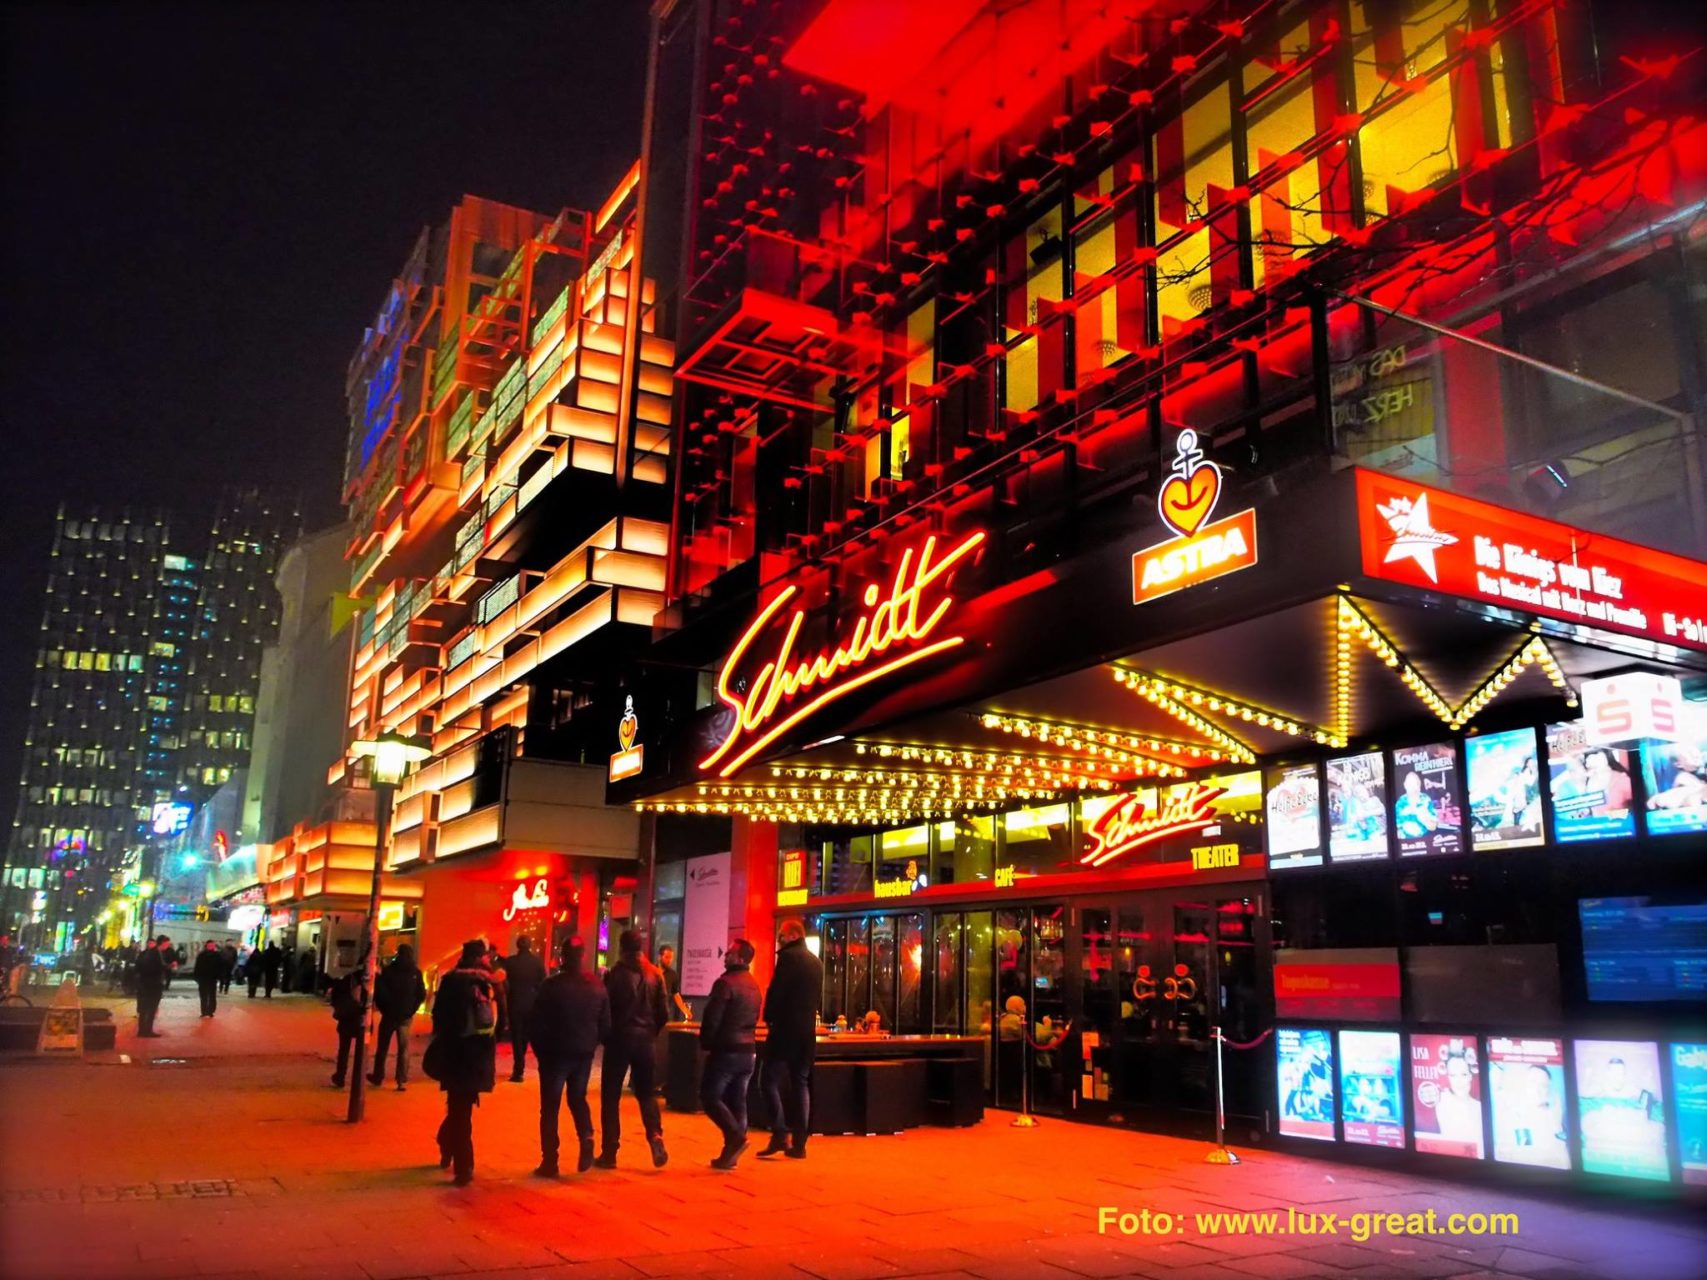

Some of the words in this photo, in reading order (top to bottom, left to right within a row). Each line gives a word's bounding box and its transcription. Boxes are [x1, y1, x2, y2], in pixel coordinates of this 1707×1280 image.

[1140, 527, 1248, 590] ASTRA
[699, 531, 985, 771] Schmidt
[1080, 785, 1220, 864] Schmidt
[874, 877, 913, 898] hausbar
[1191, 844, 1239, 870] THEATER
